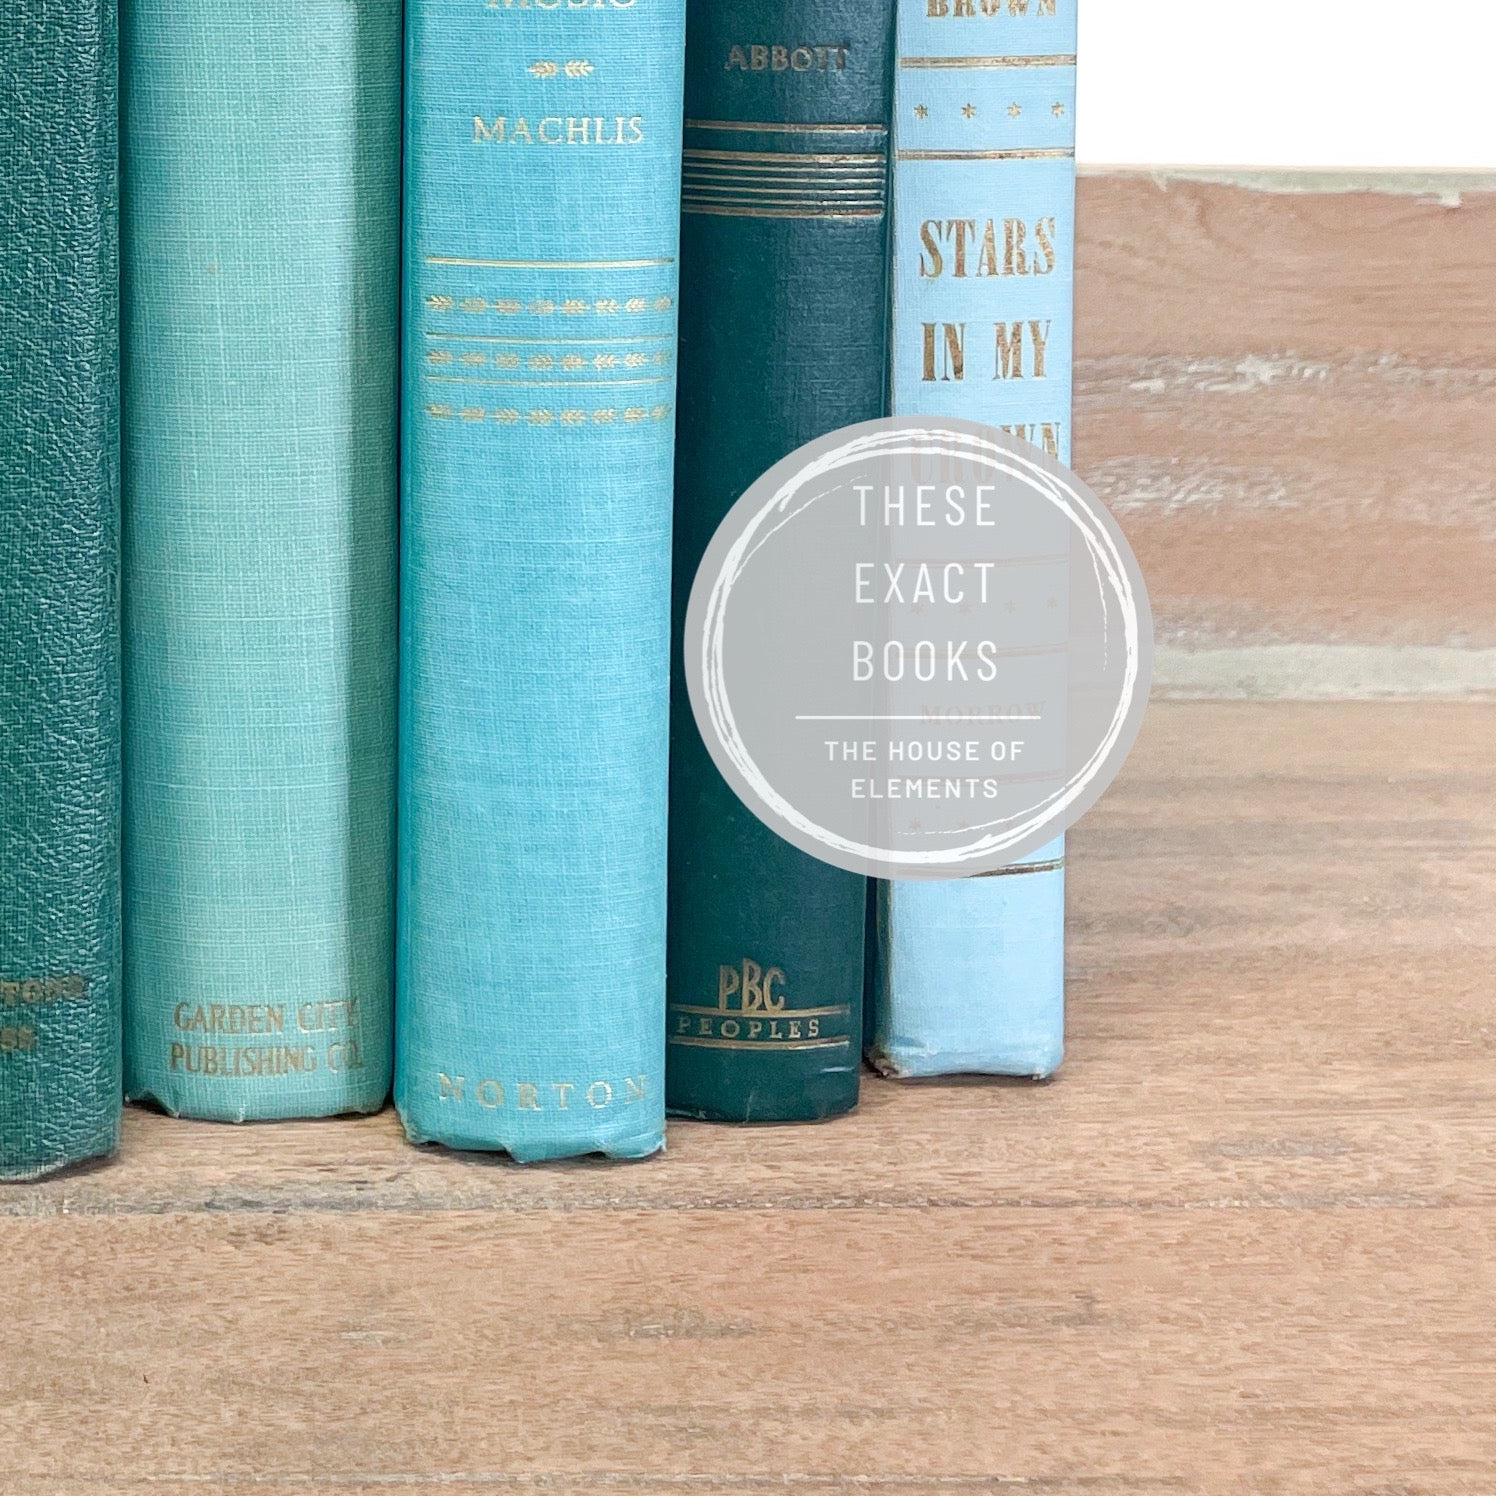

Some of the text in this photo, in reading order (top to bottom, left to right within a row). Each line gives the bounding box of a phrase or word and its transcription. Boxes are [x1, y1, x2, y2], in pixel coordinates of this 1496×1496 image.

[724, 44, 850, 72] ABBOTT
[472, 115, 646, 146] MACHLIS
[919, 216, 1057, 278] STARS
[921, 320, 1052, 382] IN MY
[718, 957, 786, 1012] PBC
[173, 1001, 284, 1034] GARDEN
[678, 1016, 820, 1039] PEOPLES
[170, 1042, 317, 1077] PUBLISHING
[438, 1072, 649, 1111] NORTON
